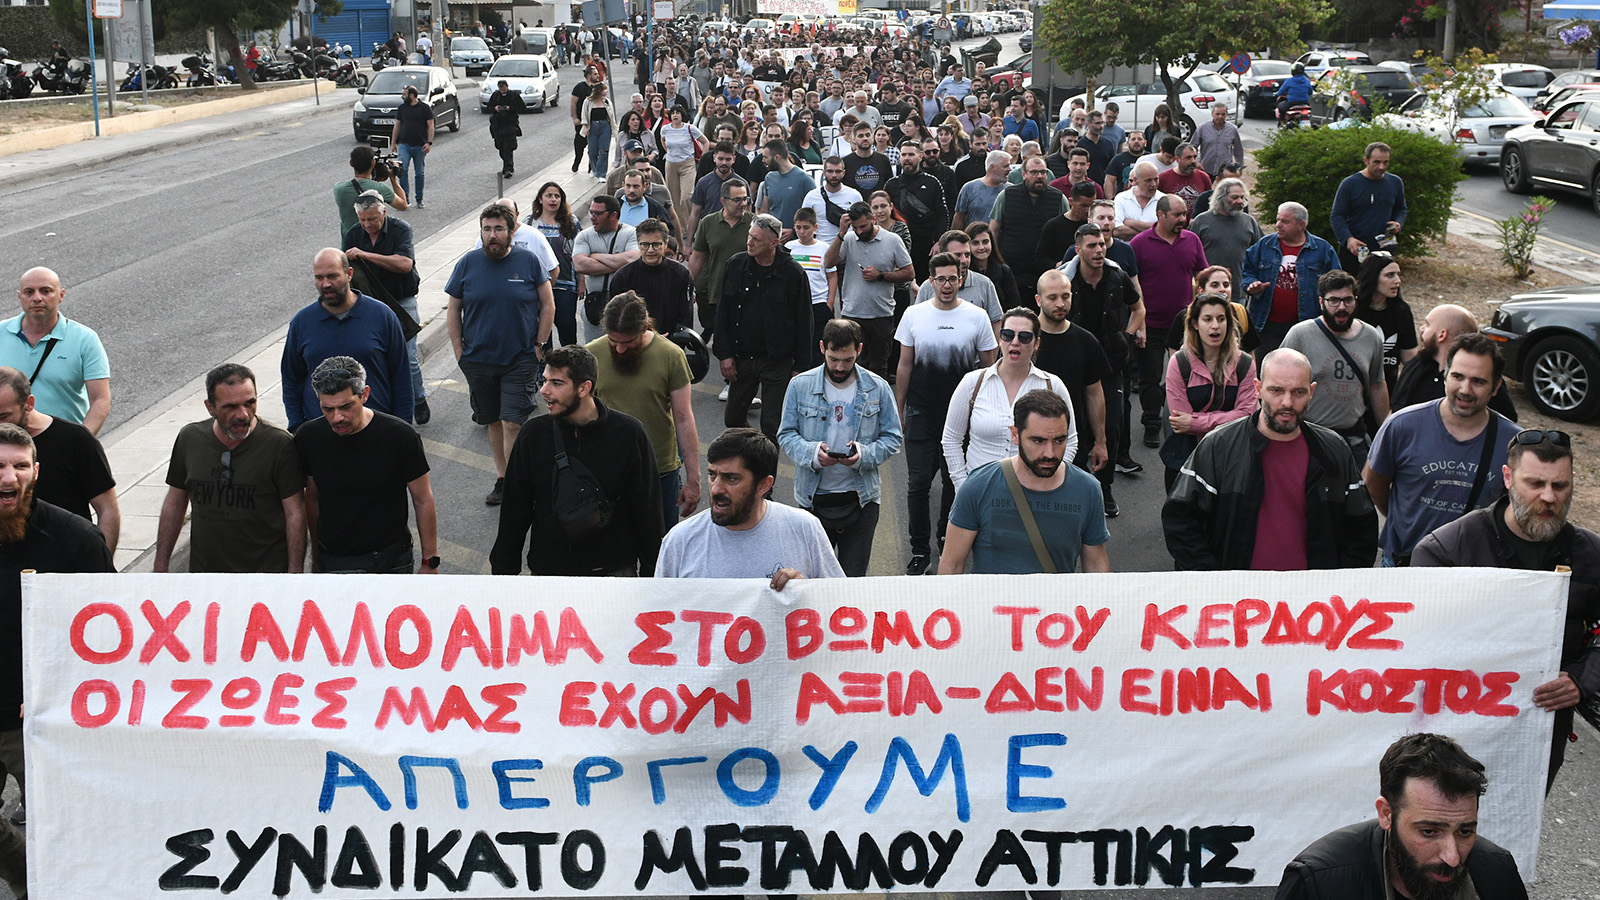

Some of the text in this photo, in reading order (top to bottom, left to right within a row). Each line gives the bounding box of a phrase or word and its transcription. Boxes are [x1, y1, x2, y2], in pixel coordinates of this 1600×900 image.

[1334, 360, 1355, 380] 83
[217, 480, 256, 510] YORK
[1421, 460, 1496, 482] EDUCATIN
[991, 499, 1011, 508] LOOK
[1036, 501, 1051, 510] THE
[1053, 503, 1082, 513] MIRROR
[70, 595, 1415, 672] ΟΧΙ ΑΛΛΟ ΑΙΜΑ ΣΤΟ ΒΩΜΟ ΤΟΥ ΚΕΡΔΟΥΣ
[71, 679, 146, 728] ΟΙ
[162, 673, 358, 730] ΖΩΕΣ
[375, 683, 527, 733] ΜΑΣ
[559, 679, 752, 735] ΕΧΟΥΝ
[1120, 667, 1273, 717] ΕΙΝΑΙ
[1307, 668, 1520, 717] ΚΟΣΤΟΣ
[319, 733, 1067, 822] ΑΠΕΡΓΟΥΜΕ
[159, 822, 1255, 898] ΣΥΝΔΙΚΑΤΟ ΜΕΤΑΛΛΟΥ ΑΤΤΙΚΗΣ
